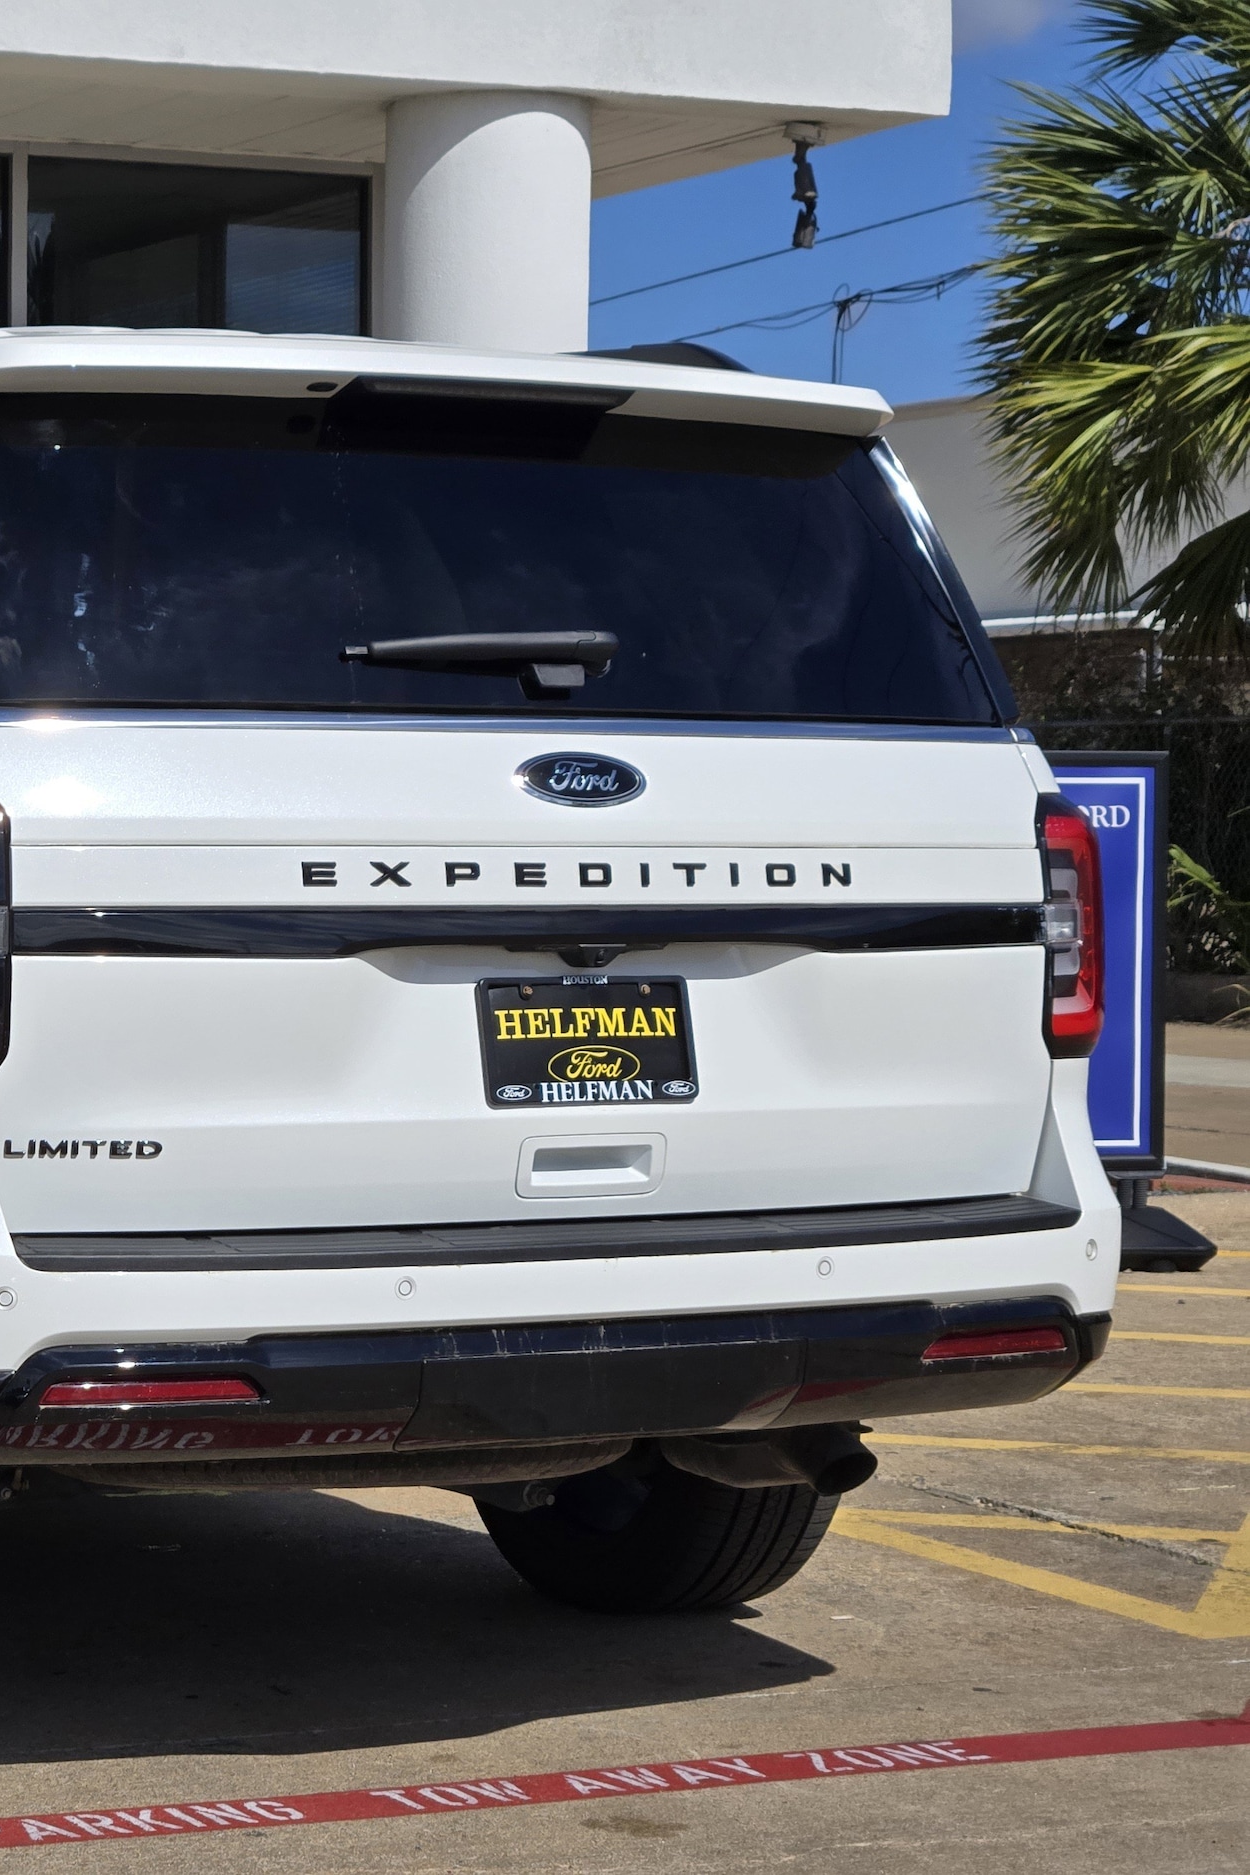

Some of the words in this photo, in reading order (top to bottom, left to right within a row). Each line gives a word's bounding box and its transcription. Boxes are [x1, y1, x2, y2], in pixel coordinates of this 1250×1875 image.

[549, 760, 620, 792] Ford
[301, 861, 853, 888] EXPEDITION
[562, 975, 608, 986] HOUSTON
[494, 1007, 677, 1040] HELFMAN
[566, 1050, 623, 1079] Ford
[539, 1079, 654, 1102] HELFMAN
[3, 1139, 163, 1160] LIMITED
[368, 1779, 533, 1810] TOW
[562, 1757, 767, 1796] AWAY
[783, 1740, 992, 1773] ZONE
